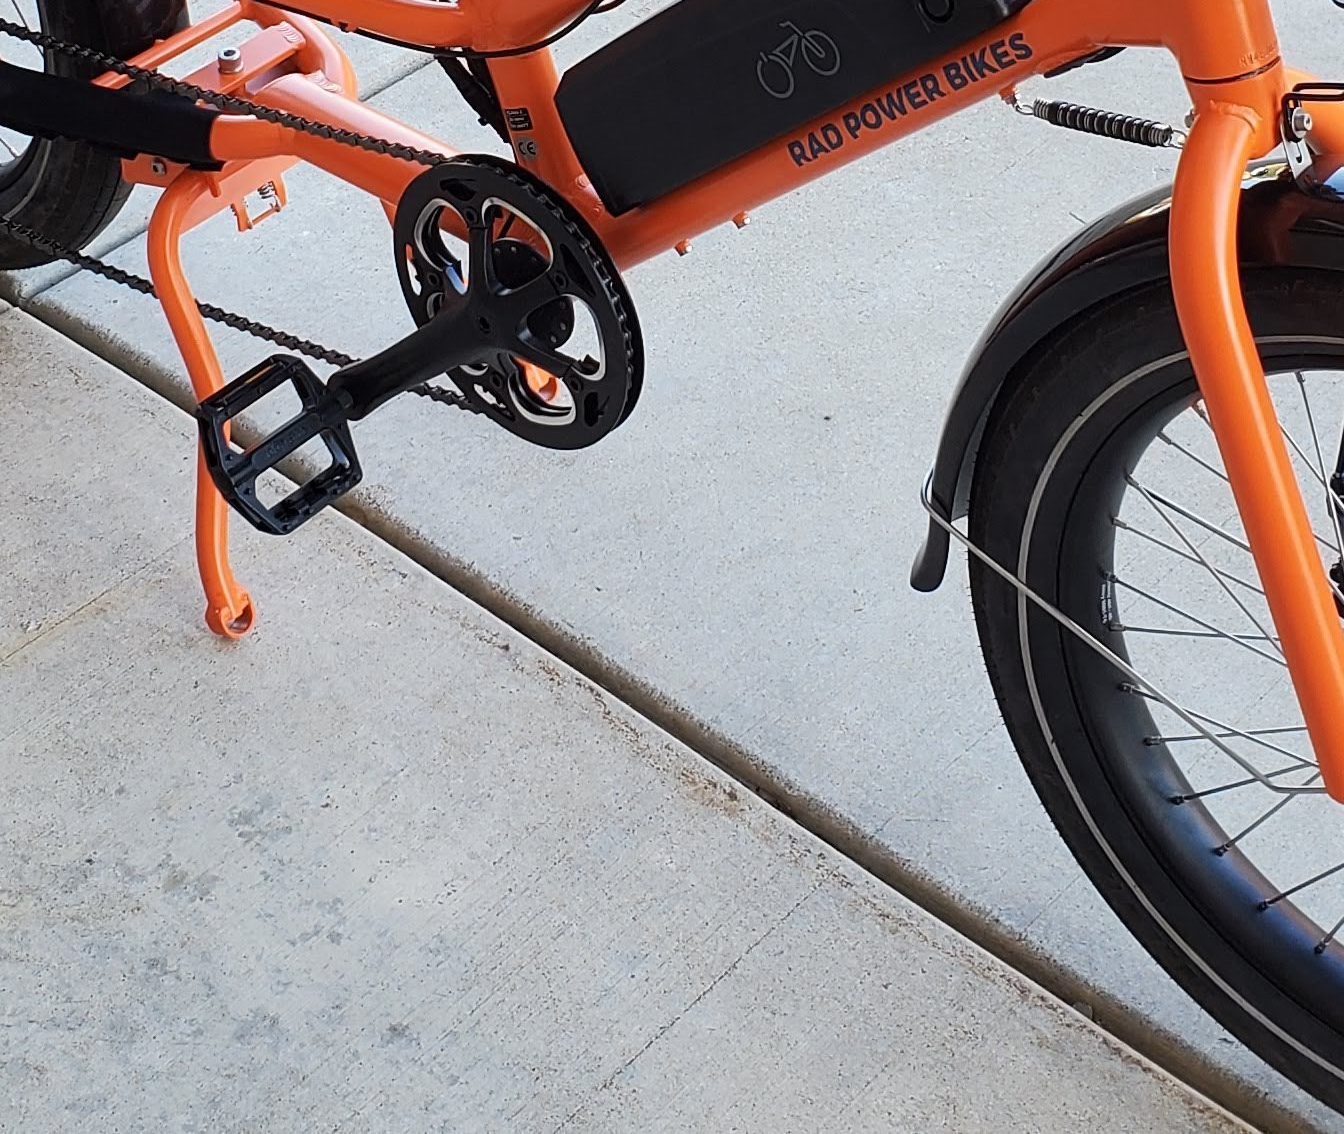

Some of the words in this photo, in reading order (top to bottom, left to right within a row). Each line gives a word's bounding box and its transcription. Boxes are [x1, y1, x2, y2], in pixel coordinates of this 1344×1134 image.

[787, 123, 844, 167] RAD
[842, 72, 947, 140] POWER
[943, 32, 1034, 92] BIKES
[517, 141, 537, 156] CE
